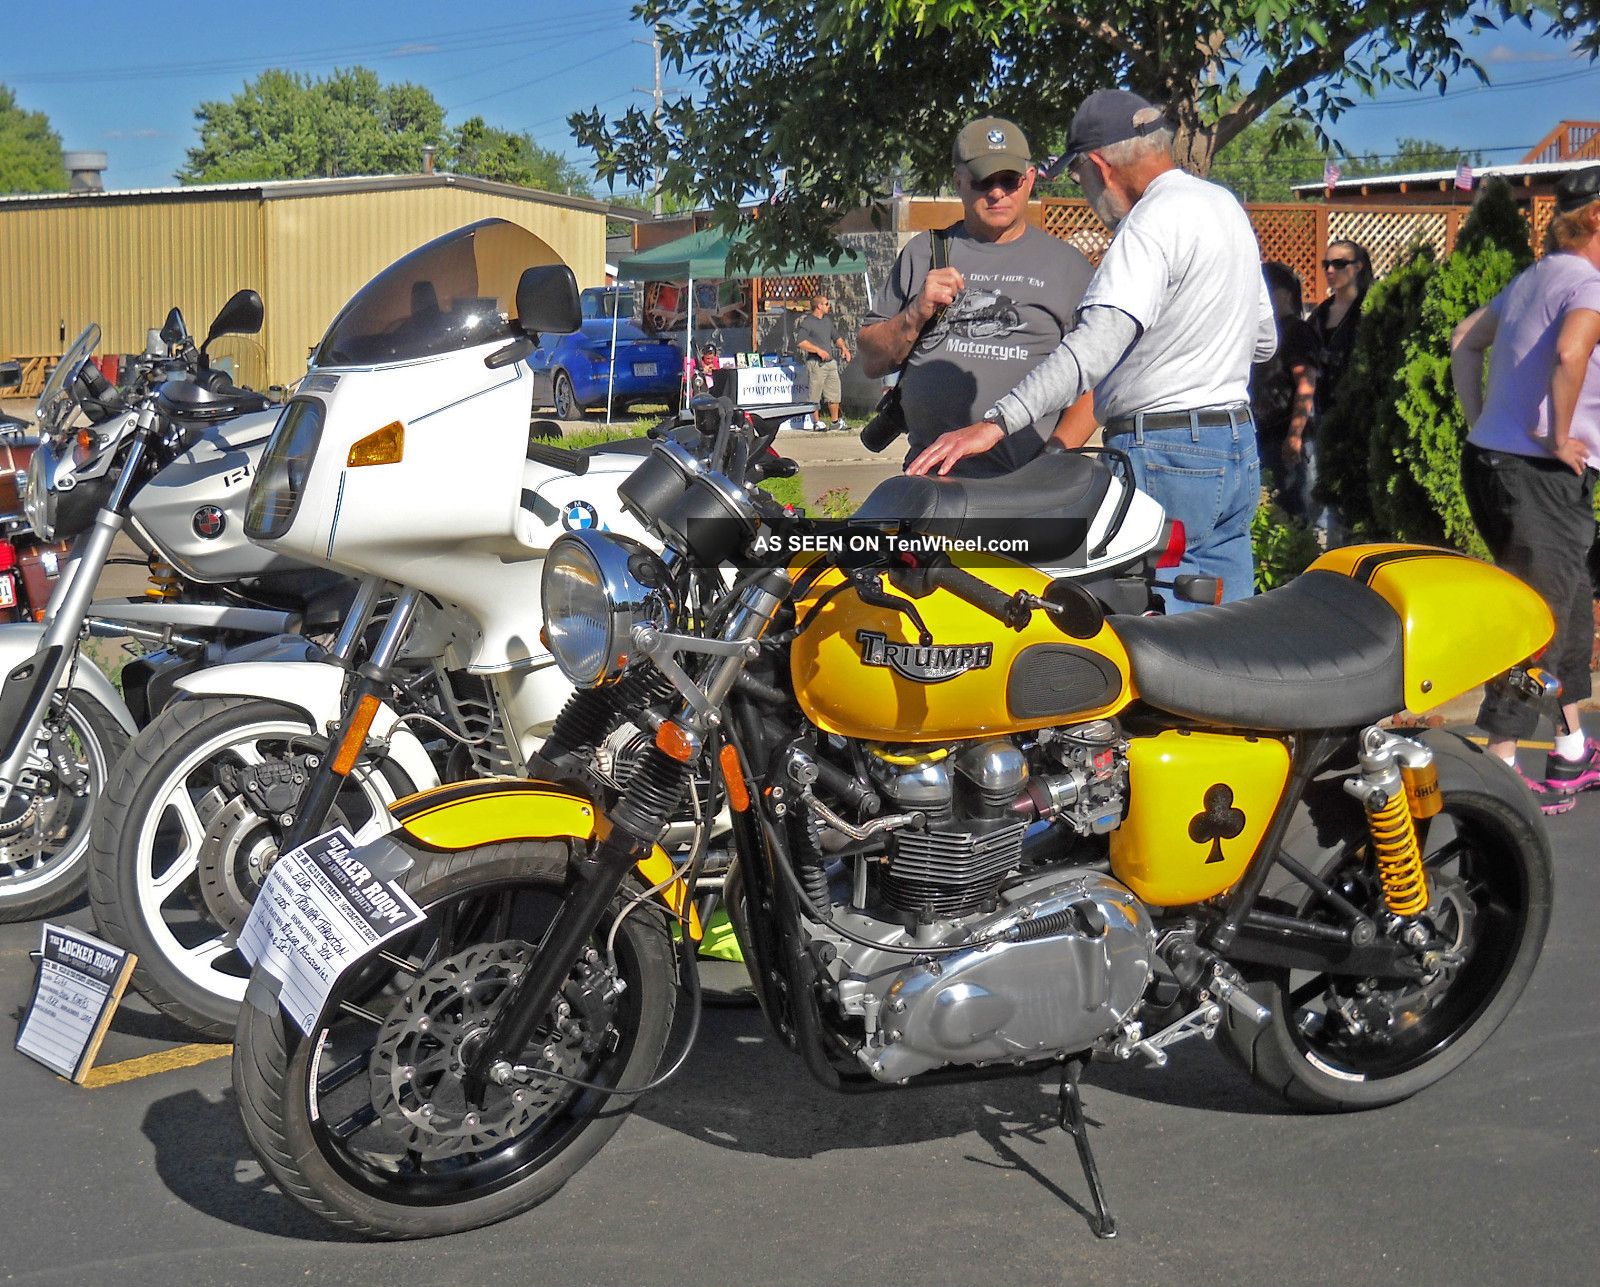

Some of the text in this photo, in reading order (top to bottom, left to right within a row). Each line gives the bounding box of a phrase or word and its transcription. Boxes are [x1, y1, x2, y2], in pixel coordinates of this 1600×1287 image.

[970, 273, 1000, 281] DON'T
[1001, 274, 1025, 283] HIDE
[945, 338, 1029, 361] Motorcycle
[858, 631, 992, 667] TRIUMPH
[328, 862, 349, 884] SPORTS
[348, 886, 373, 913] SPIRITS
[361, 880, 407, 924] ROOM
[58, 938, 94, 964] LOCKER
[92, 951, 118, 973] ROOM
